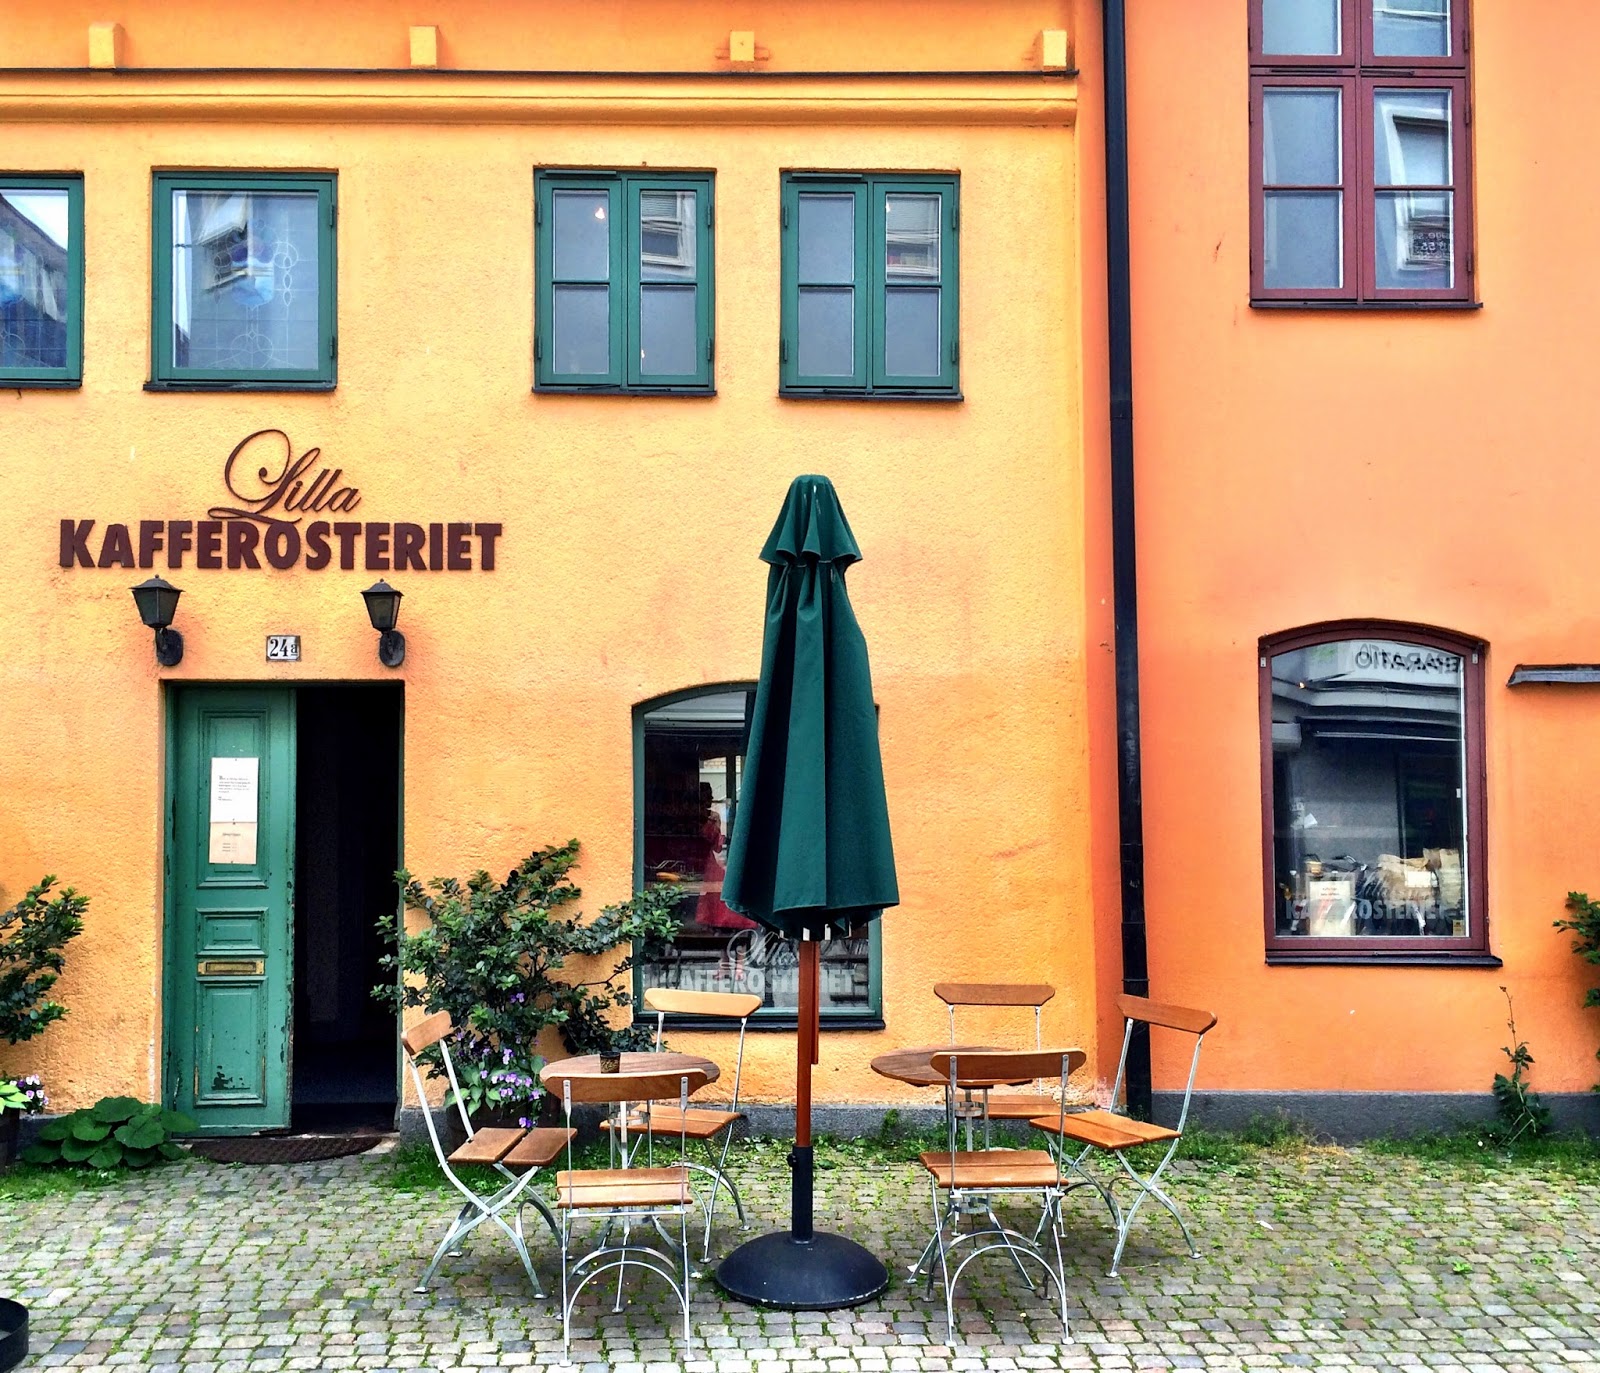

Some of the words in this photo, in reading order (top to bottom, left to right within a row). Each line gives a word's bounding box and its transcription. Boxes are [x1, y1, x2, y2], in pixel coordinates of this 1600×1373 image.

[208, 429, 361, 523] Lilla
[59, 519, 502, 570] KAFFEROSTERIET
[269, 639, 298, 657] 24a
[1286, 899, 1450, 919] KAOSTERIET
[656, 967, 856, 993] AFFEROSTIET
